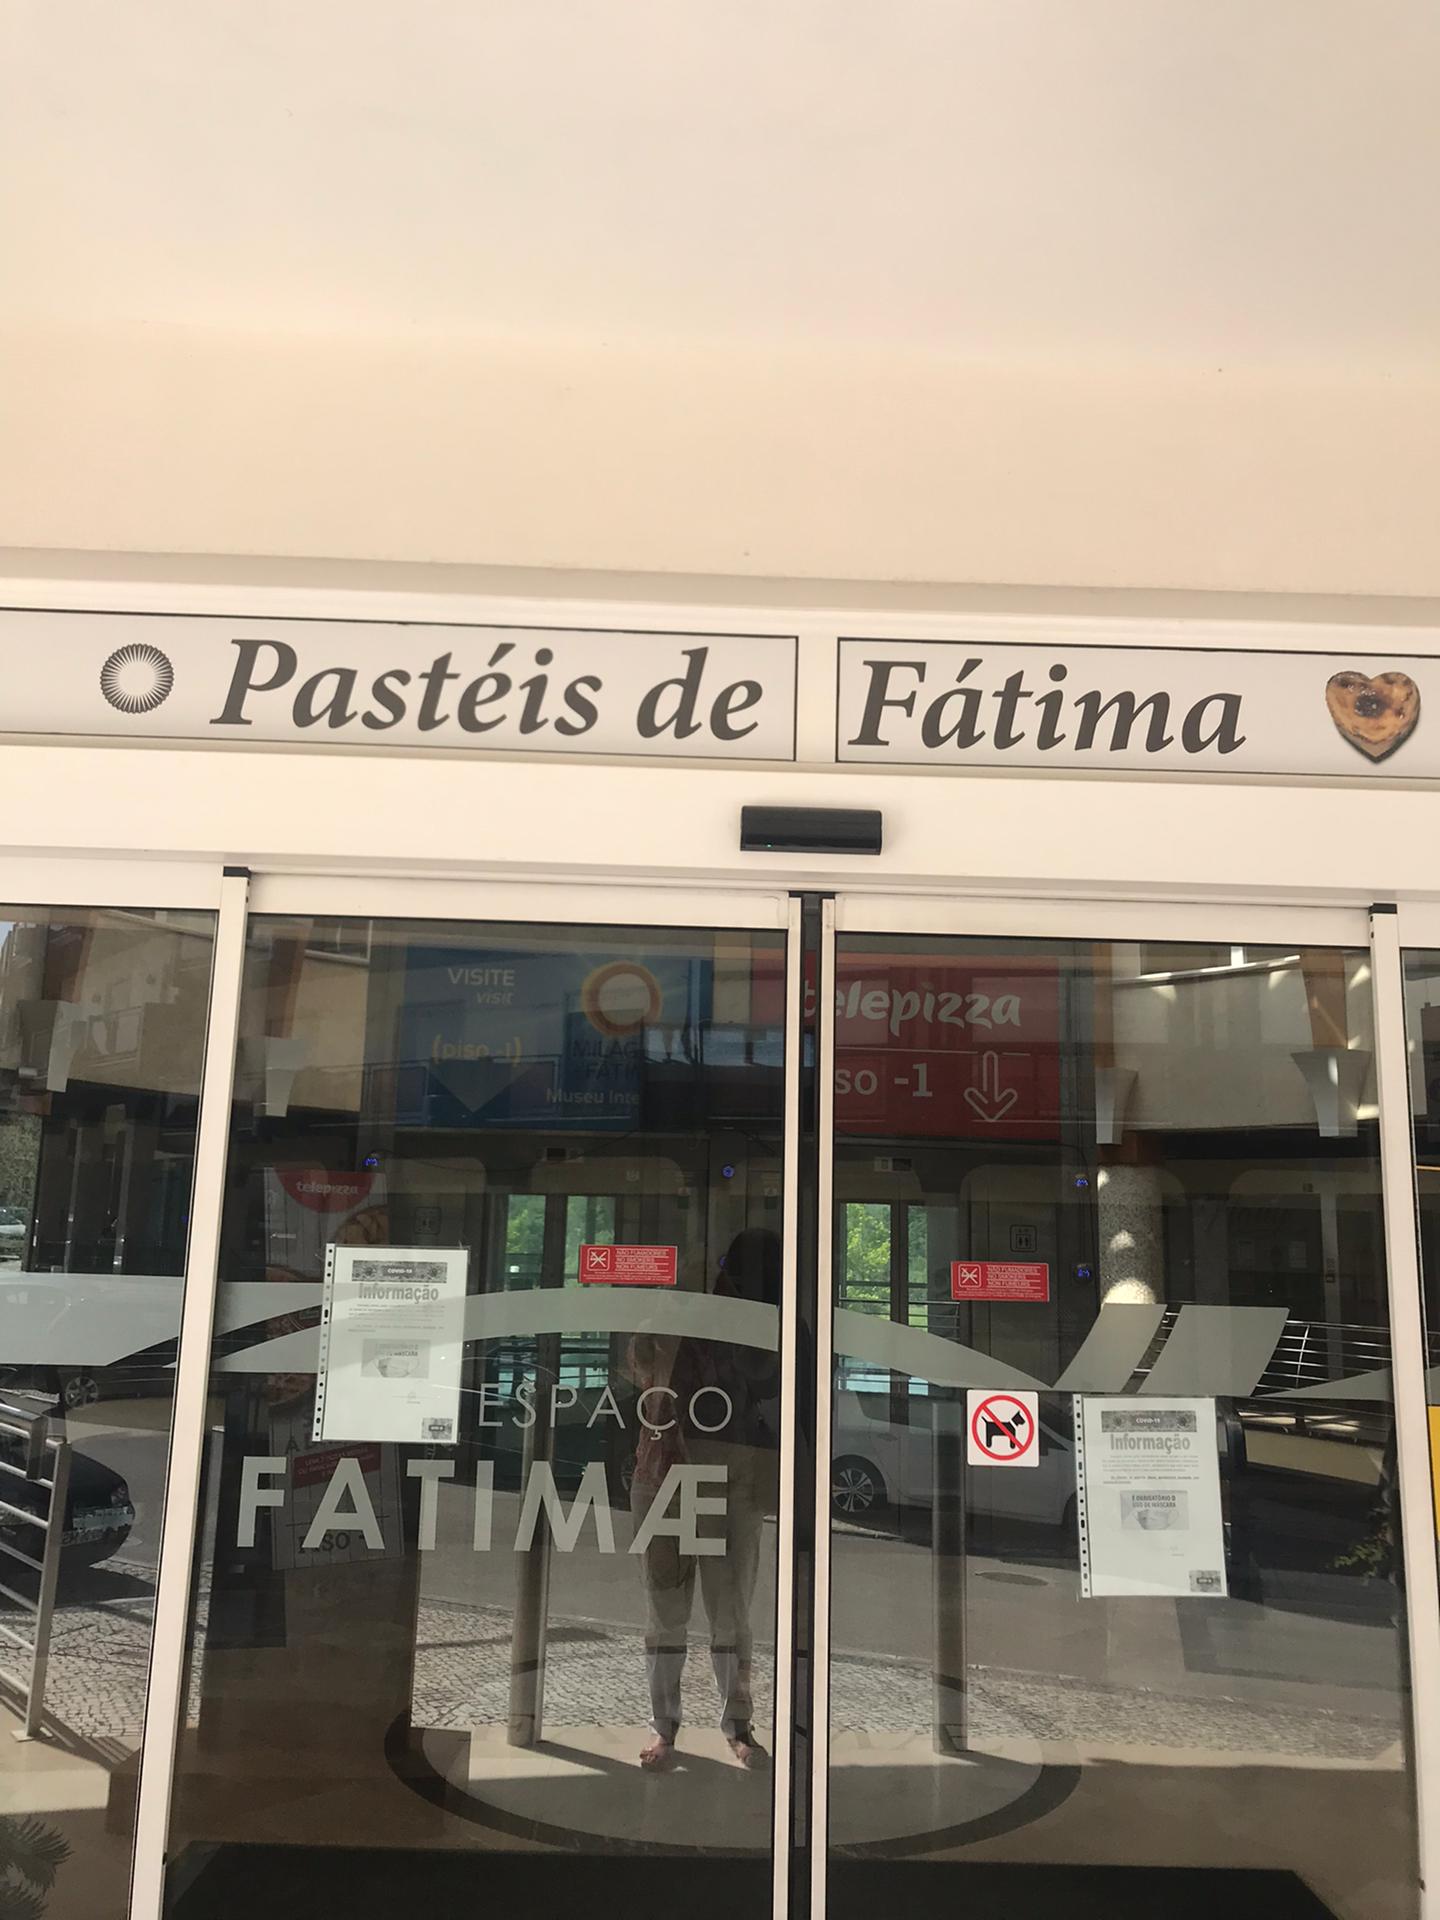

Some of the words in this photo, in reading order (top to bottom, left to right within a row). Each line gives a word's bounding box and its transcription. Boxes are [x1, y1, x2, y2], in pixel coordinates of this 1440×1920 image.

[209, 638, 603, 737] Pastéis
[636, 646, 764, 742] de
[847, 657, 1247, 755] Fátima
[448, 968, 515, 986] VISITE
[547, 1087, 605, 1105] Museu
[358, 1283, 439, 1304] Informação
[478, 1382, 733, 1440] ESPAÇO
[1110, 1433, 1191, 1454] Informação
[236, 1455, 729, 1556] FATIMÆ
